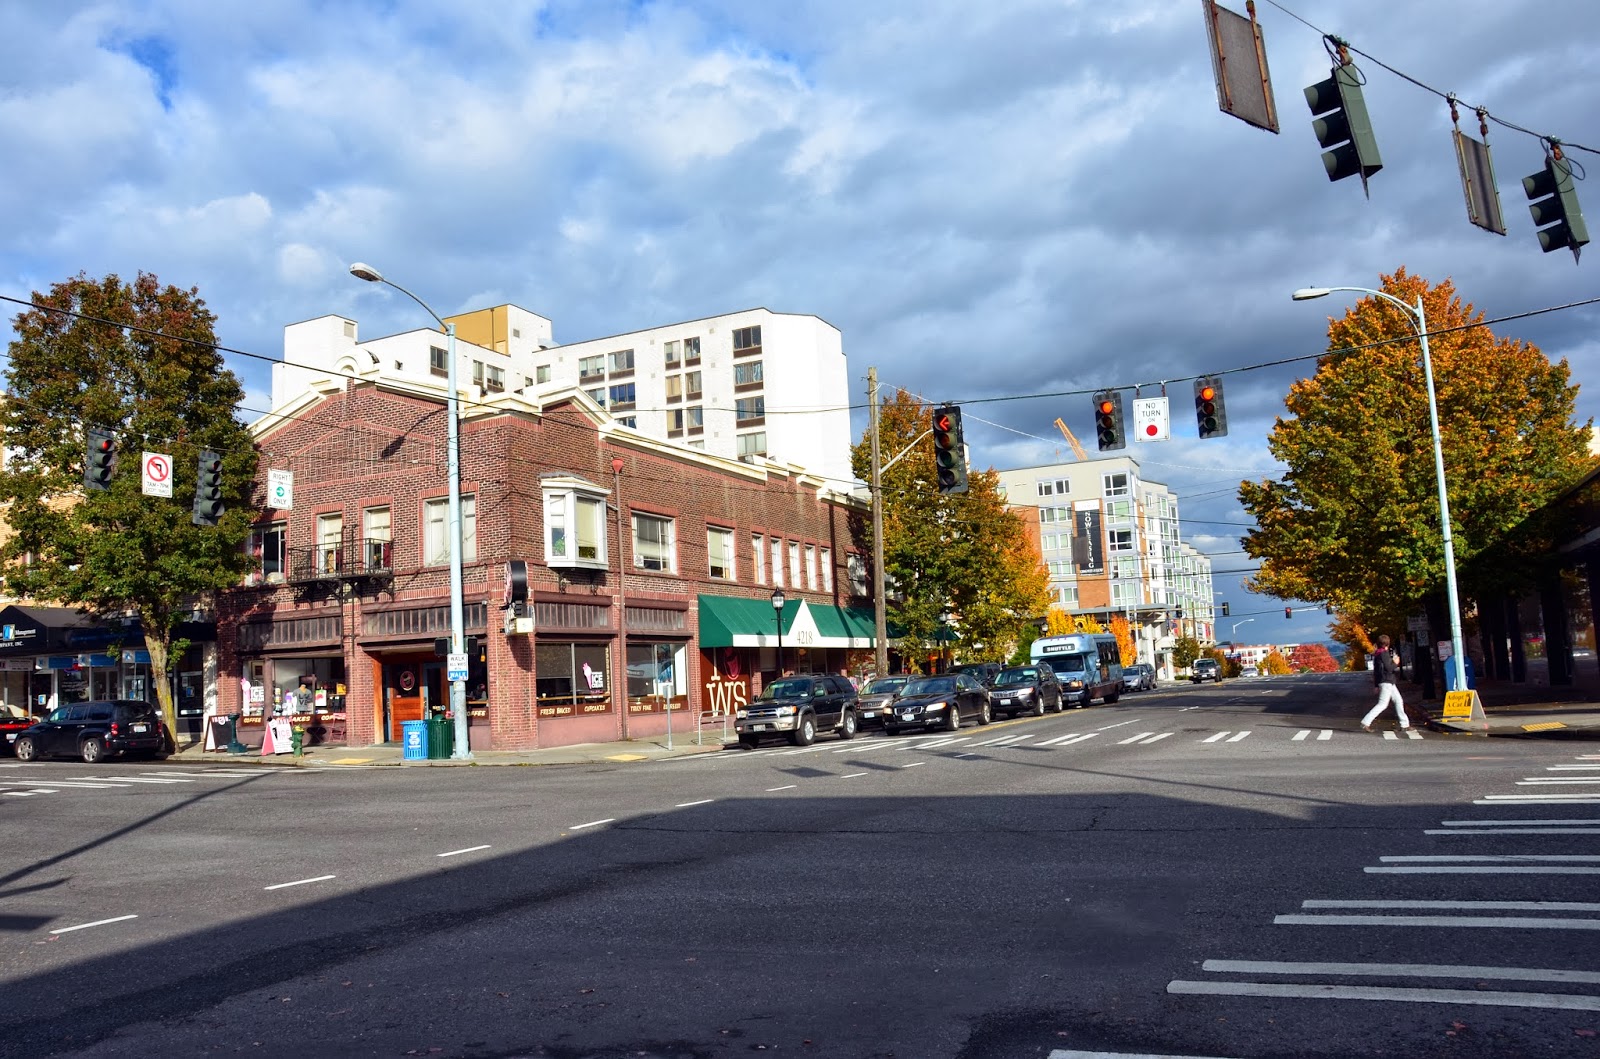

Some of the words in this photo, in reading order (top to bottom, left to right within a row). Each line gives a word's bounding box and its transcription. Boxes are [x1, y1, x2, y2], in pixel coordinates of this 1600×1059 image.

[1084, 512, 1092, 528] NOW
[797, 631, 813, 645] 4218
[1447, 694, 1465, 702] Adopt
